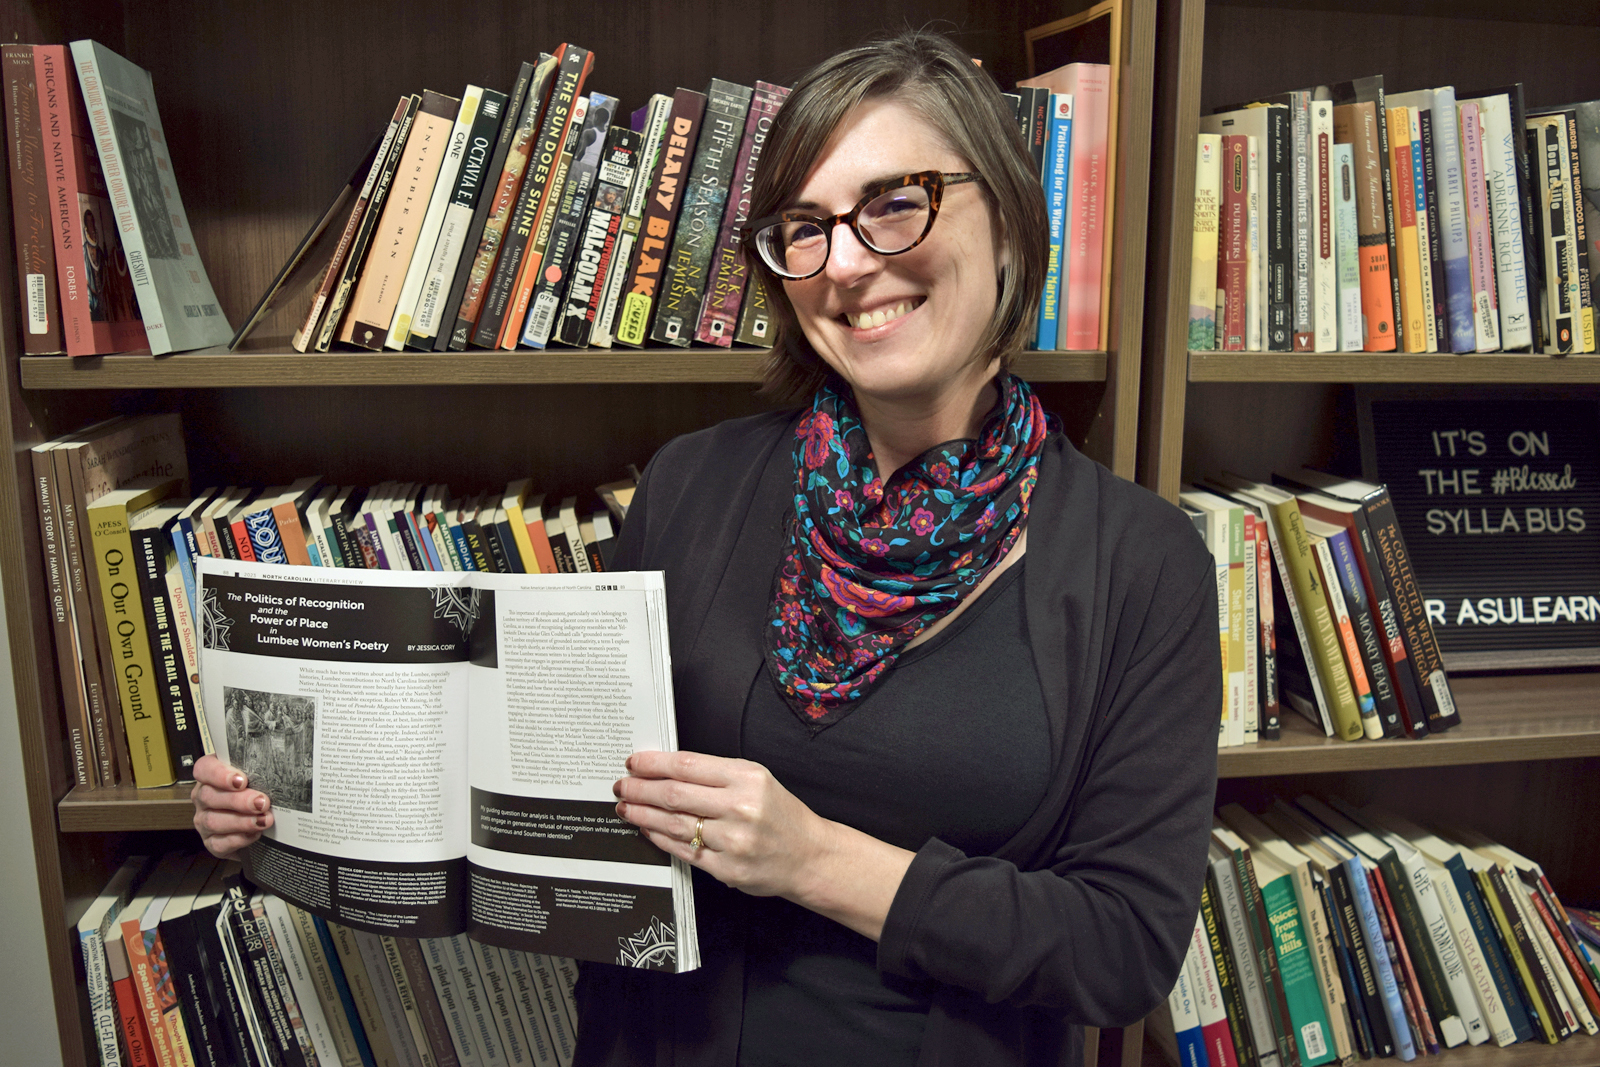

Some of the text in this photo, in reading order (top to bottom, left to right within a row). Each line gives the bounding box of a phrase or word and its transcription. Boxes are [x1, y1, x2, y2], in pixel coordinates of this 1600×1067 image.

[559, 73, 579, 103] THE
[519, 100, 540, 147] THRALL
[549, 106, 568, 138] SUN
[725, 134, 735, 149] THE
[1035, 121, 1044, 146] STONE
[1569, 119, 1577, 149] MURDER
[43, 54, 72, 249] AFRICANS AND NATIVE AMERICANS
[80, 60, 136, 233] THE CONJURE WOMAN AND OTHER CONJURE TALES
[451, 132, 465, 159] CANE
[457, 137, 489, 199] OCTAVIA E.
[535, 141, 556, 184] DOES
[656, 116, 692, 212] DELANY
[1297, 107, 1307, 223] IMAGINED COMMUNITIES
[1422, 118, 1433, 181] PABLO NERUDA
[1571, 152, 1578, 160] AT
[561, 180, 578, 215] CHILDREN
[571, 172, 591, 218] UNCLE TOM'S
[687, 119, 733, 248] FIFTH SEASON
[1051, 125, 1068, 238] Praisesong for the Widow
[1414, 143, 1424, 208] CISNEROS
[1470, 159, 1479, 209] Hibiscus
[518, 188, 541, 236] SHINE
[538, 162, 568, 245] AUGUST WILSON
[1322, 210, 1328, 219] IN
[1493, 170, 1512, 273] ADRIENNE RICH
[1573, 176, 1584, 224] NIGHTWOOD
[470, 167, 518, 303] NATASHA TRETHEWEY
[66, 265, 77, 300] FORBES
[129, 251, 149, 286] CHESNUTT
[502, 277, 512, 289] Ray
[506, 246, 522, 276] Anthony
[566, 209, 611, 320] MALCOLM X
[586, 215, 621, 323] THE AUTOBIOGRAPHY OF
[667, 250, 692, 310] JEMISIN
[684, 265, 701, 298] N. K.
[1298, 228, 1308, 325] BENEDICT ANDERSON
[495, 290, 508, 316] Hinton
[1044, 275, 1058, 320] Marshall
[1432, 428, 1550, 457] IT'S ON
[1418, 463, 1577, 495] THE #Blessed
[97, 520, 122, 529] APESS
[370, 530, 382, 552] JUNK
[1426, 508, 1586, 535] SYLLABUS
[40, 477, 65, 623] HAWAII'S STORY BY HAWAII'S QUEEN
[143, 537, 158, 579] HAUSMAN
[456, 538, 473, 570] INDIAN
[227, 593, 364, 611] The Politics of Recognition
[1246, 545, 1254, 642] THINNING BLOOD
[1377, 528, 1430, 686] SAMSON OCCOM, MOHEGAN
[105, 549, 152, 721] On Our Own Ground
[174, 587, 196, 667] Upon Her Shoulders
[250, 614, 328, 629] Power of Place
[257, 634, 389, 652] Lumbee Women's Poetry
[153, 596, 187, 731] RIDING THE TRAIL OF TEARS
[1358, 612, 1391, 700] MONKEY BEACH
[72, 728, 86, 785] LILIUOKALANI
[490, 826, 513, 835] Indigenous
[547, 832, 573, 840] identities?
[1413, 866, 1433, 896] GIPE
[1269, 906, 1298, 926] Voices
[1274, 918, 1298, 938] from
[1281, 931, 1296, 944] the
[1194, 928, 1218, 1010] Appalachia Inside Out
[1279, 939, 1302, 956] Hills
[1430, 913, 1464, 981] TRAMPOLINE
[1459, 928, 1499, 1014] EXPLORATIONS
[137, 963, 160, 1026] Speaking Up,
[433, 964, 471, 1057] piled upon mountains
